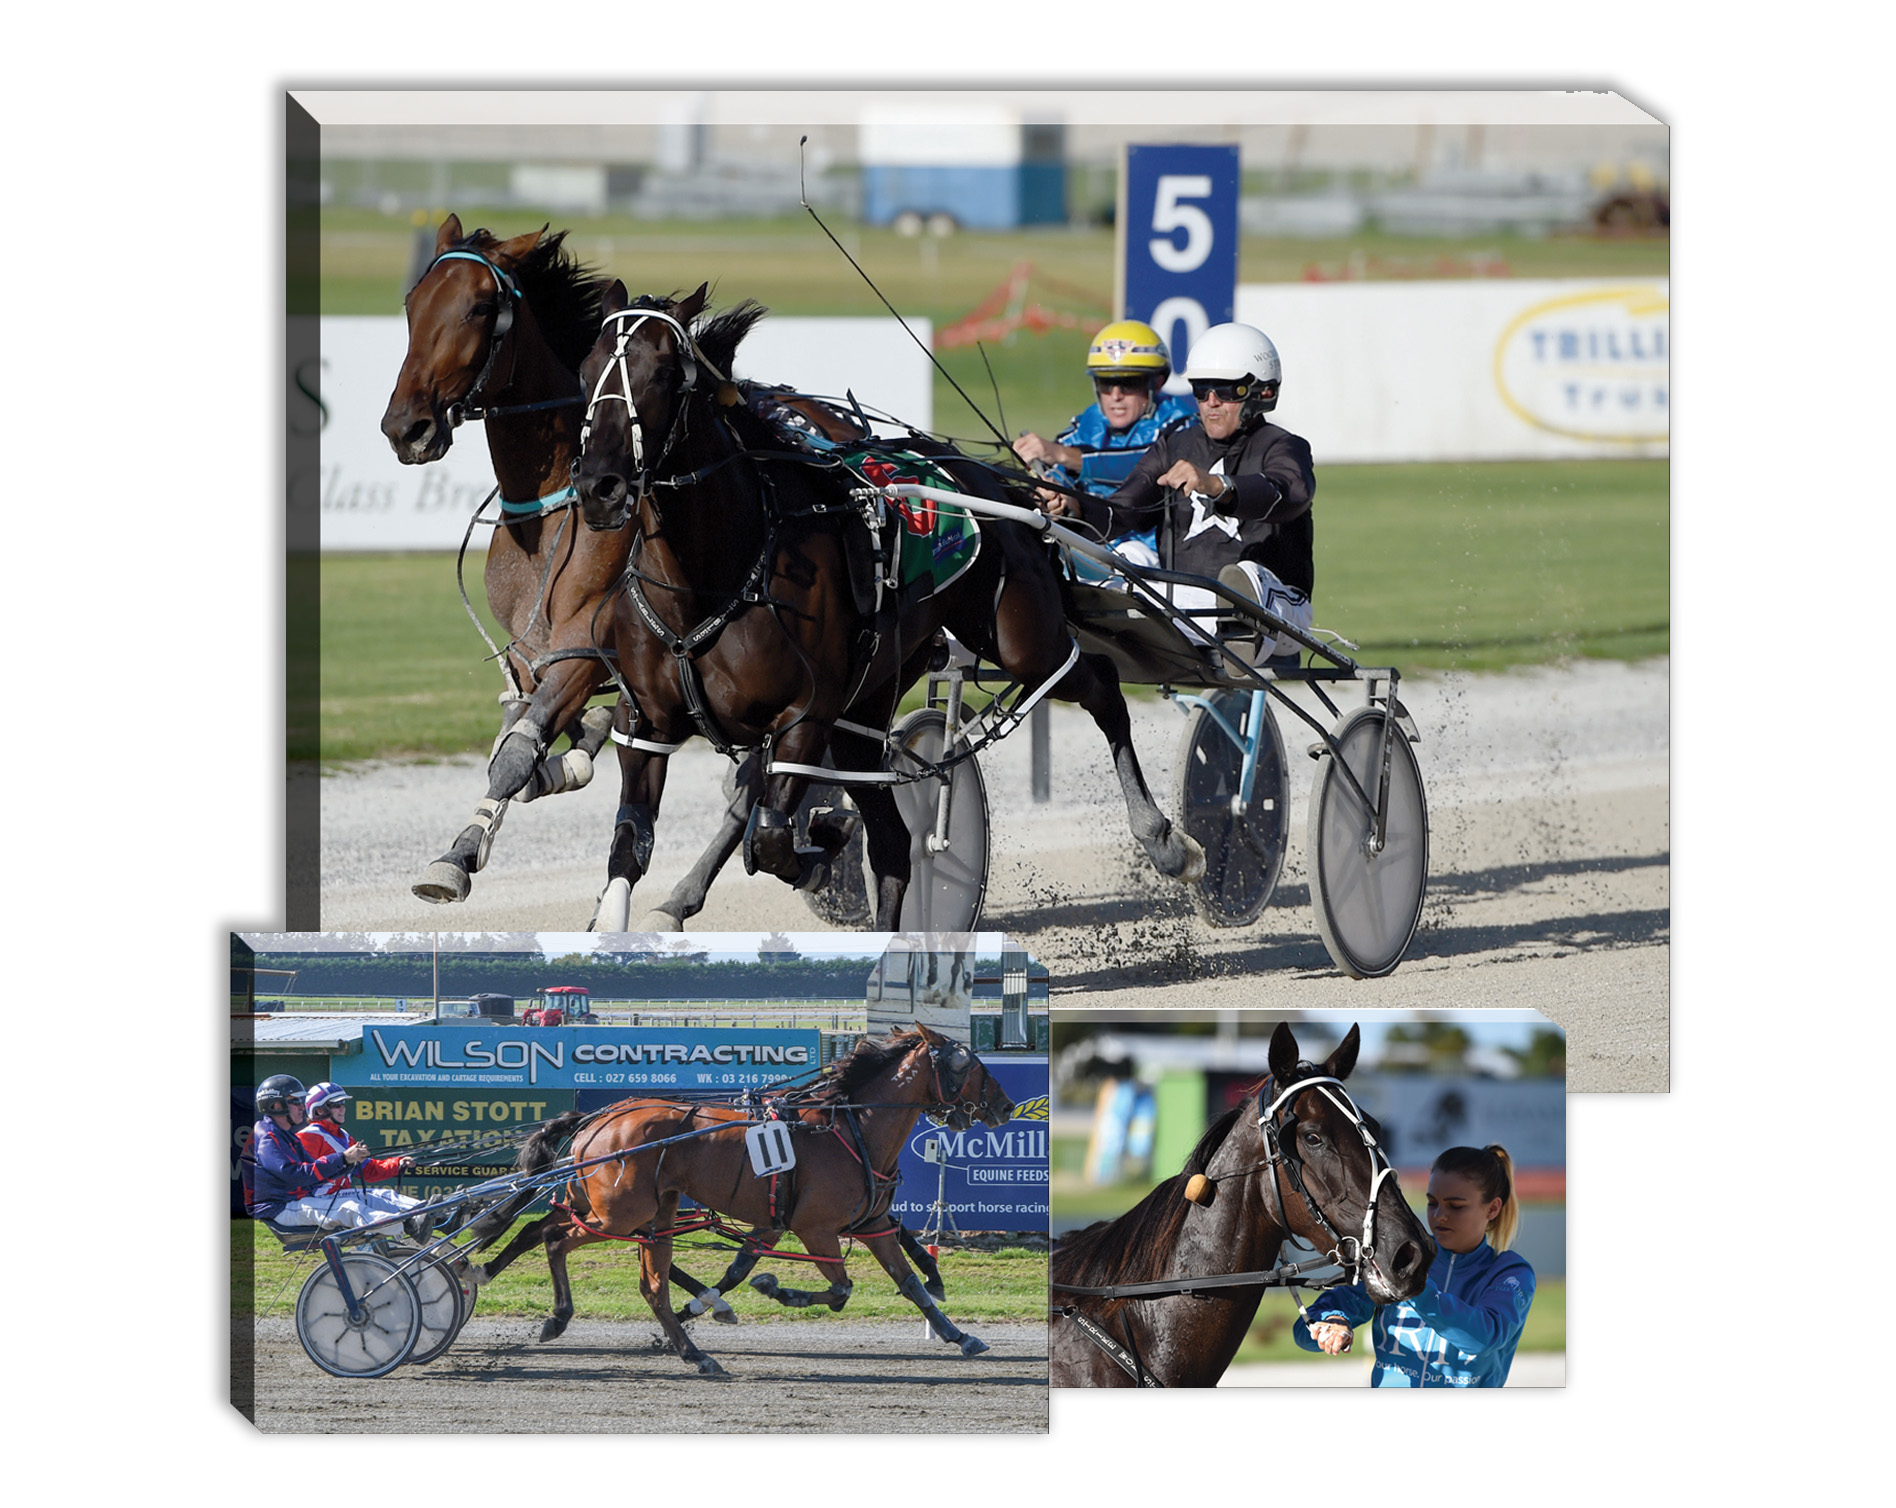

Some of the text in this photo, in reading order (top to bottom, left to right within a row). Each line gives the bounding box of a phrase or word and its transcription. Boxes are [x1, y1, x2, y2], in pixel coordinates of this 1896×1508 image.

[630, 586, 665, 637] STABLES
[372, 1029, 808, 1084] WILSON CONTRACTING
[370, 1073, 524, 1083] ALL YOUR EXCAVATION AND CARTAGE REQUIREMENTS
[574, 1073, 596, 1083] CELL
[606, 1074, 625, 1084] 027
[628, 1074, 648, 1084] 659
[651, 1074, 677, 1084] 8066
[697, 1074, 712, 1083] WK
[722, 1074, 735, 1083] 03
[738, 1074, 758, 1083] 216
[355, 1101, 546, 1121] BRIAN STOTT
[936, 1130, 1049, 1159] McMill
[415, 1166, 469, 1176] SERVICE
[973, 1169, 1049, 1182] EQUINE FEEDS
[910, 1202, 924, 1212] to
[978, 1201, 1013, 1213] horse
[1077, 1316, 1117, 1350] STRIKE
[1376, 1360, 1392, 1371] our
[1394, 1362, 1420, 1379] horse.
[1423, 1370, 1443, 1383] Our
